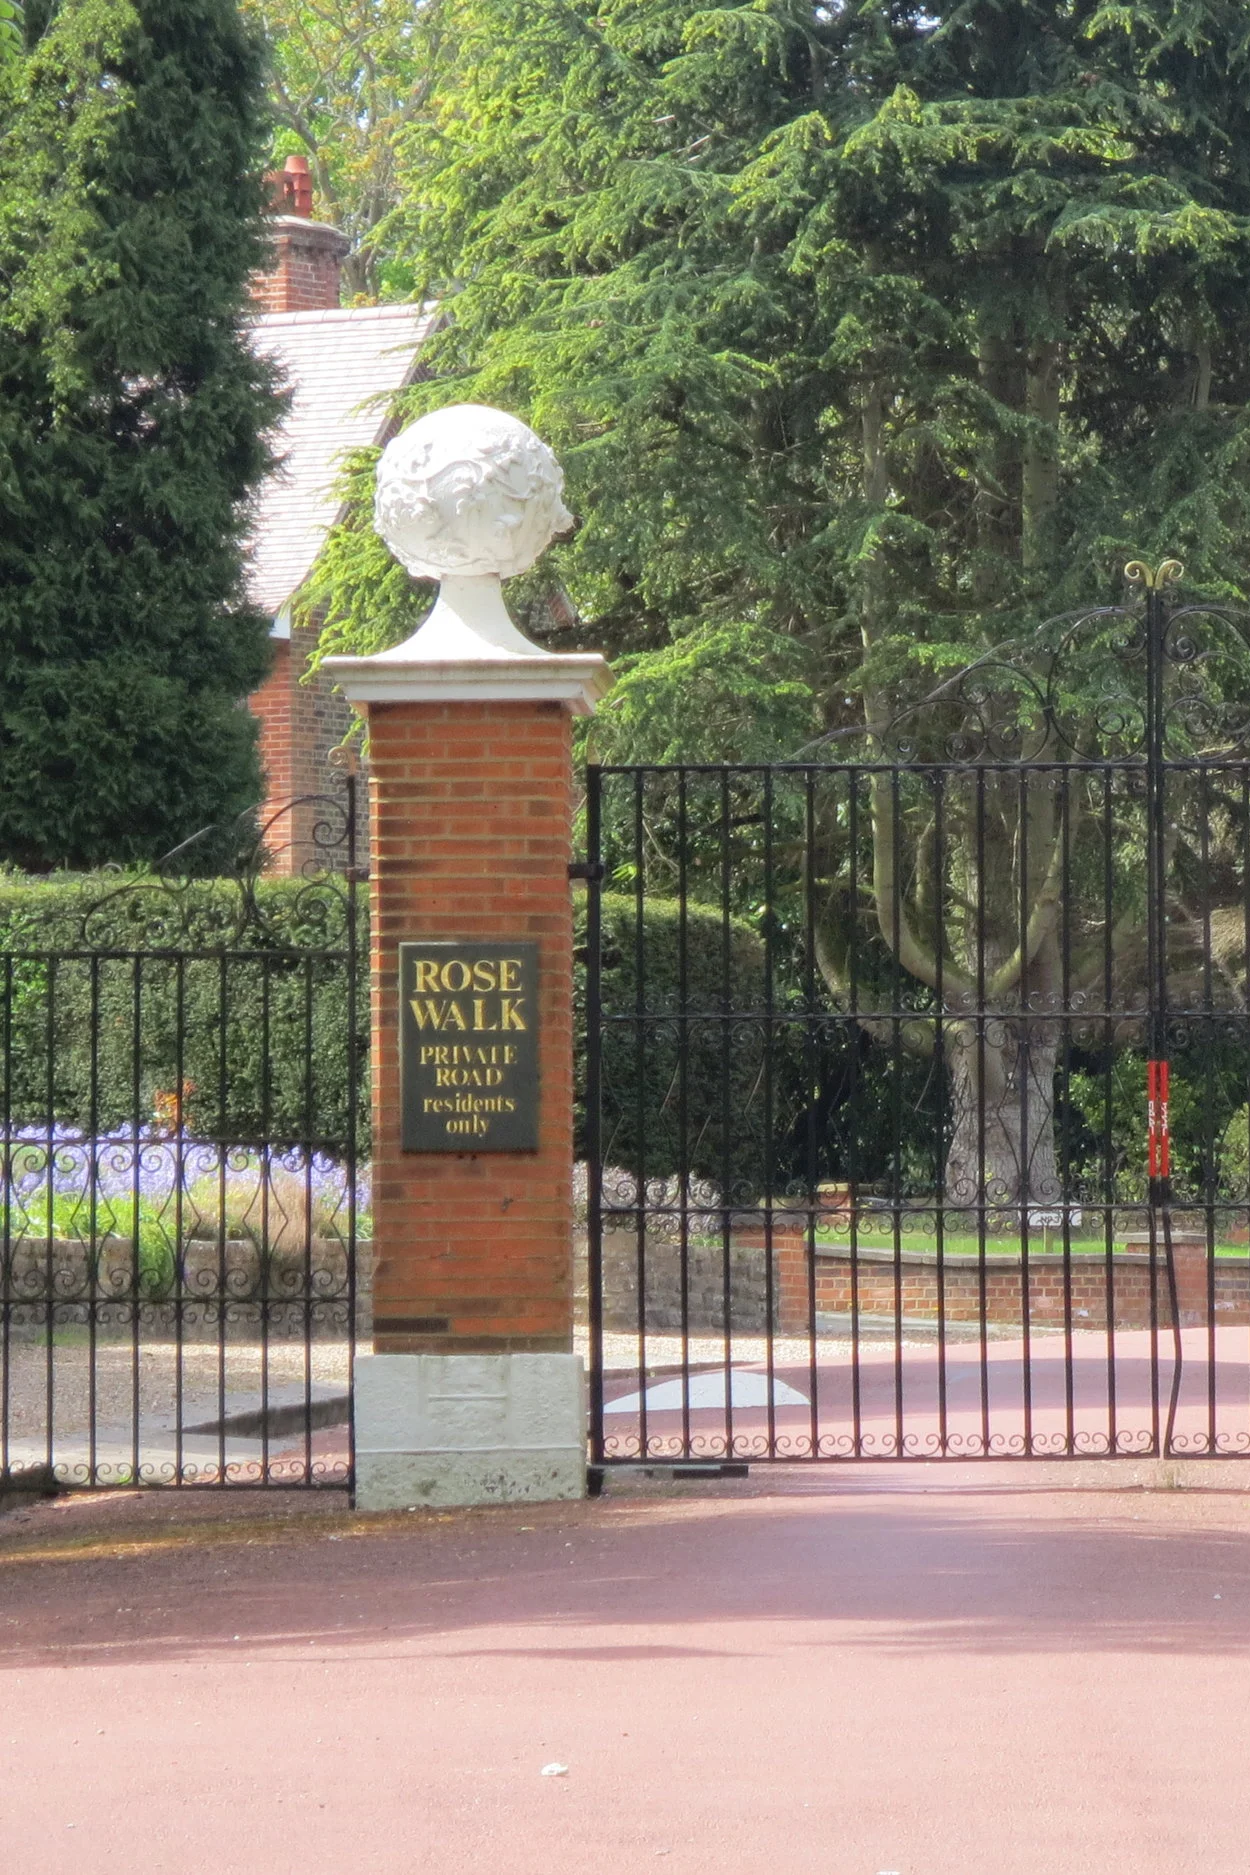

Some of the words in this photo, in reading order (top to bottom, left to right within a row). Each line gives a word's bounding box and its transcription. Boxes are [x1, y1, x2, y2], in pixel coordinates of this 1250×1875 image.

[413, 959, 522, 993] ROSE
[409, 999, 527, 1031] WALK
[420, 1045, 518, 1065] PRIVATE
[435, 1067, 504, 1087] ROAD
[423, 1092, 516, 1113] residents
[446, 1114, 490, 1138] only
